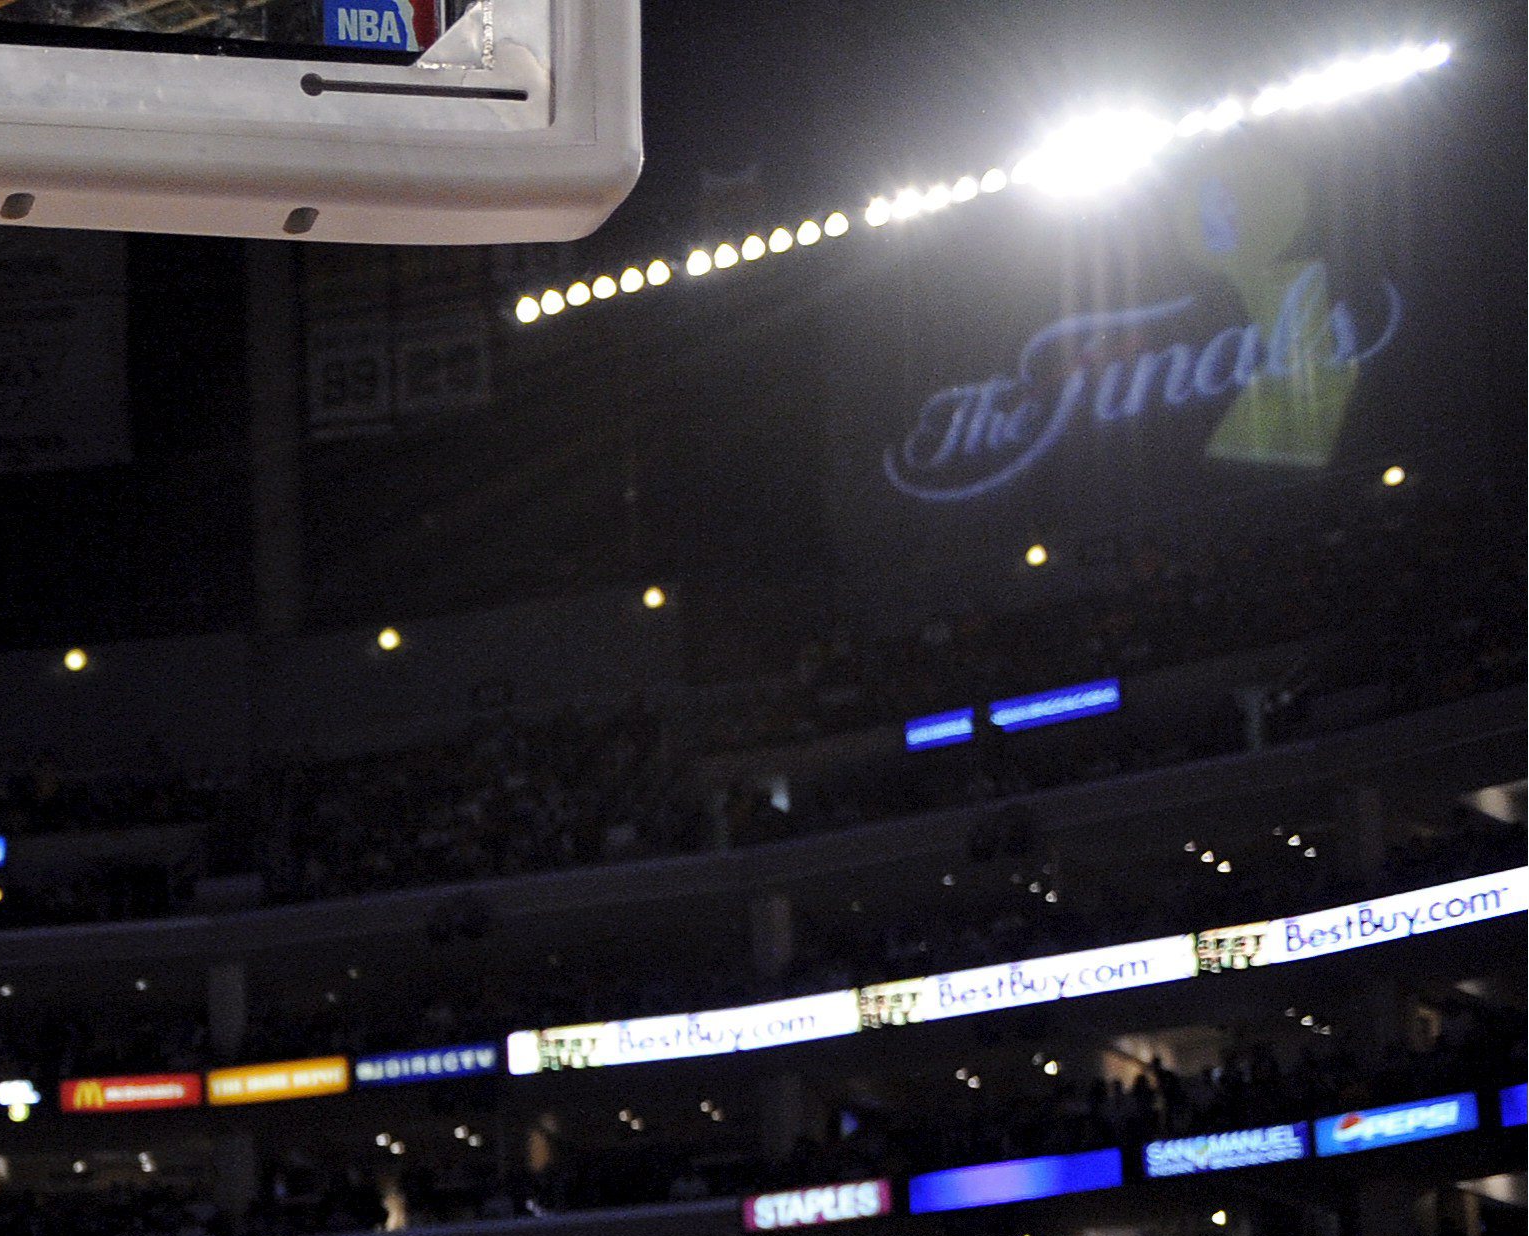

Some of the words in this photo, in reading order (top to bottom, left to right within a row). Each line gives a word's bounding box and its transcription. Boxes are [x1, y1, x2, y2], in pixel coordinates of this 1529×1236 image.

[337, 7, 401, 44] NBA
[883, 262, 1404, 500] Finals
[904, 372, 1043, 467] The
[1284, 886, 1504, 953] BestBuy.com
[753, 1181, 881, 1230] STAPLES
